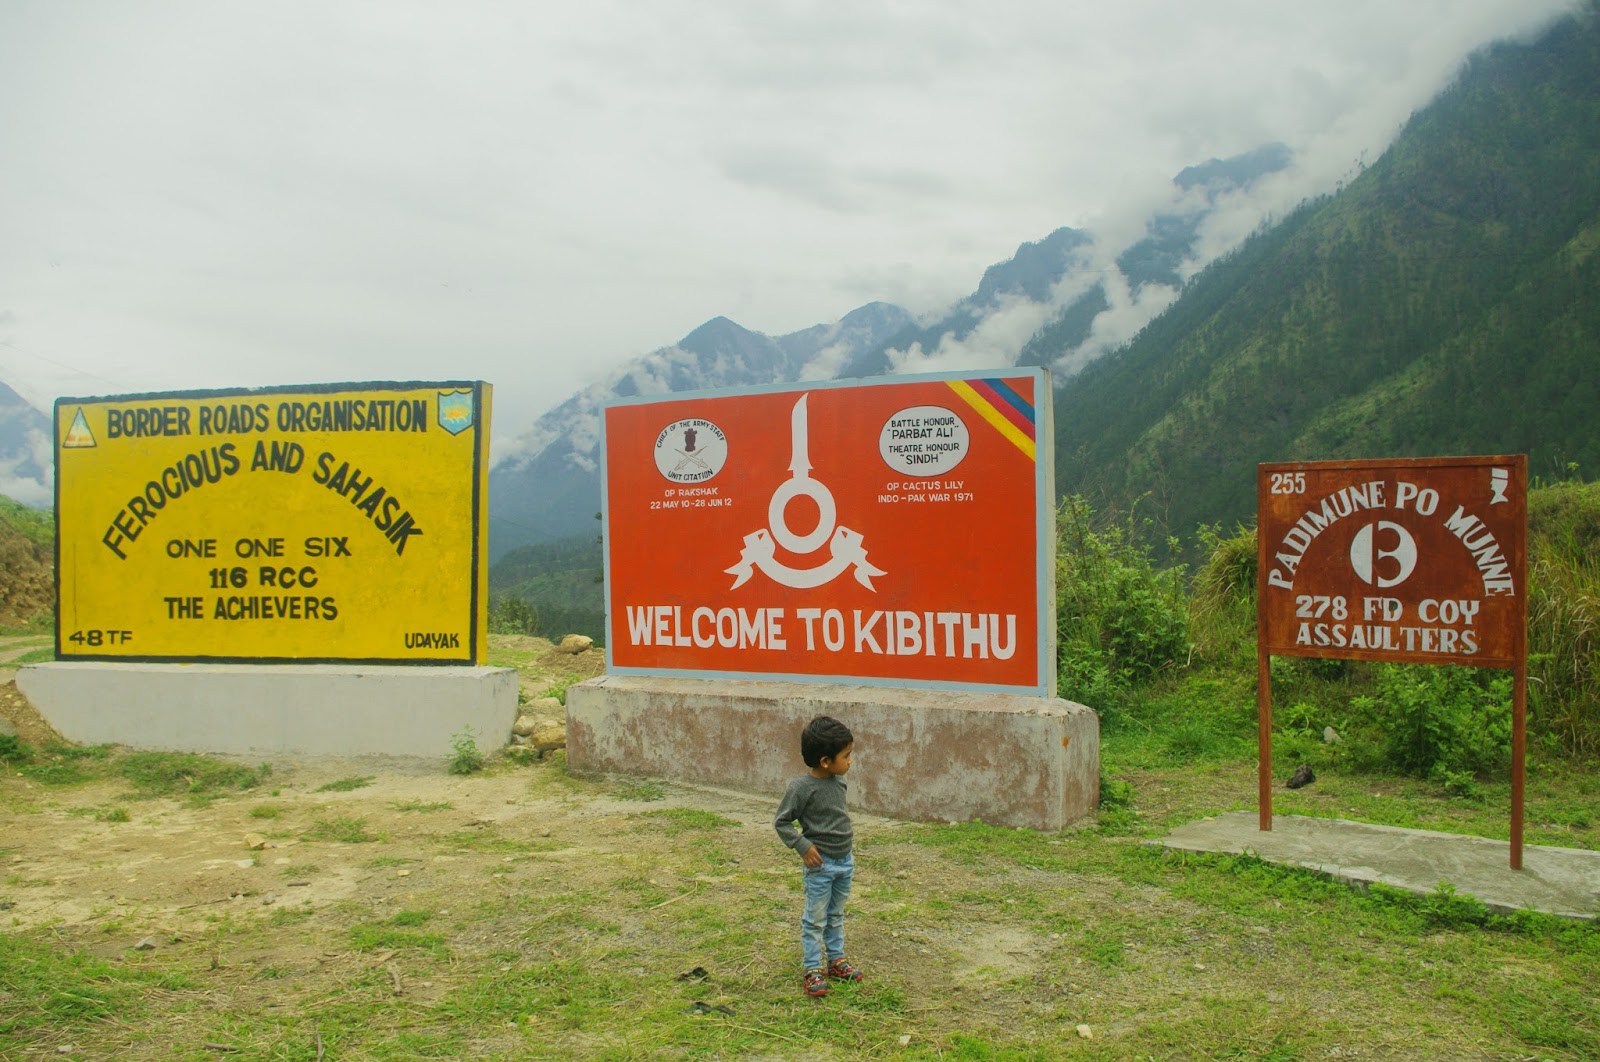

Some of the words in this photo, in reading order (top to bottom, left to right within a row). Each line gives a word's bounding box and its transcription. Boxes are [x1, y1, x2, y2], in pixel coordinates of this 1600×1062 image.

[108, 406, 190, 438] BORDER
[200, 404, 269, 435] ROADS
[277, 400, 427, 433] ORGANISATION
[892, 419, 920, 427] BATTLE
[924, 417, 954, 426] HONOUR
[657, 430, 668, 448] CHIEF
[710, 425, 724, 441] STAFF
[889, 444, 922, 453] THEATRE
[926, 443, 959, 451] HONOUR
[668, 471, 682, 480] UNIT
[684, 469, 714, 480] CITATION
[903, 481, 940, 490] CACTUS
[945, 481, 964, 489] LILY
[1270, 472, 1306, 495] 255
[102, 443, 240, 560] FEROCIOUS
[251, 440, 304, 474] AND
[313, 452, 424, 556] SAHASIK
[679, 487, 718, 496] RAKSHAK
[929, 494, 950, 502] WAR
[954, 493, 974, 501] 1971
[166, 539, 217, 558] ONE
[236, 538, 285, 558] ONE
[305, 536, 352, 557] SIX
[1268, 480, 1386, 591] PADIMUNE
[1395, 481, 1440, 516] PO
[1443, 504, 1515, 597] MUNNE
[209, 566, 248, 589] 116
[259, 566, 318, 589] RCC
[164, 597, 204, 619] THE
[214, 596, 338, 621] ACHIEVERS
[1295, 595, 1348, 620] 278
[1363, 597, 1403, 622] FD
[1418, 599, 1480, 625] COY
[404, 633, 460, 650] UDAYAK
[626, 605, 787, 651] WELCOME
[797, 607, 845, 651] TO
[854, 610, 1017, 660] KIBITHU
[1296, 622, 1478, 655] ASSAULTERS
